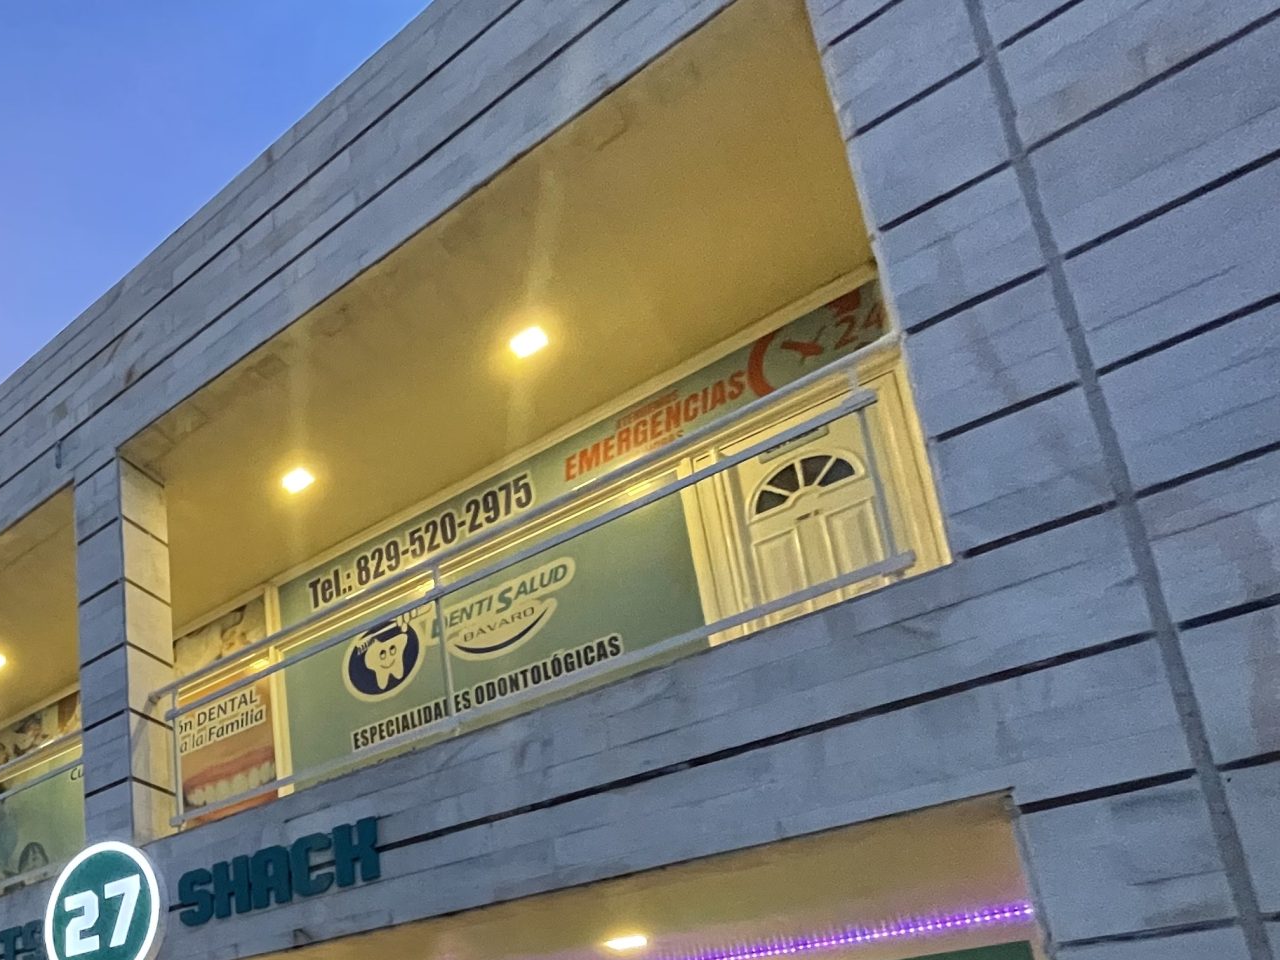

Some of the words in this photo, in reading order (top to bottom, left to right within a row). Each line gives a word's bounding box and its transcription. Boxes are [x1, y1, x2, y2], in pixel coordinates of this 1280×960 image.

[564, 369, 747, 481] EMERGENCIAS
[356, 473, 533, 587] 829-520-2975
[197, 690, 257, 727] DENTAL
[474, 635, 622, 705] ODONTOLÓGICAS
[208, 709, 264, 741] Familia
[178, 817, 382, 928] SHACK
[65, 873, 142, 958] 27
